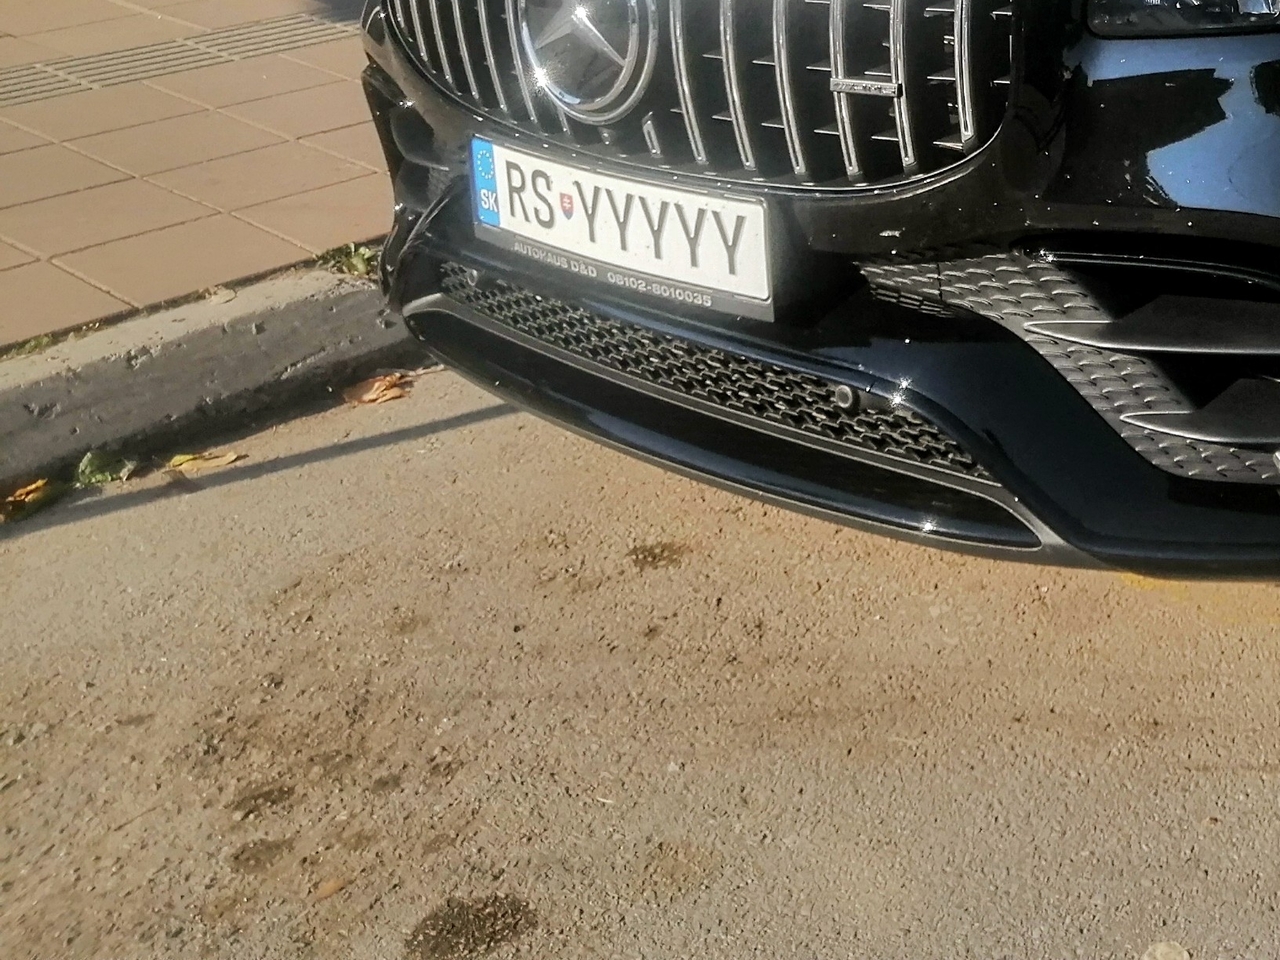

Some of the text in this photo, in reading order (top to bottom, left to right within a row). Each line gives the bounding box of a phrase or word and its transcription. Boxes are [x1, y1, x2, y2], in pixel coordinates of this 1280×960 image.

[480, 189, 498, 213] SK
[505, 160, 747, 275] RS YYYYY
